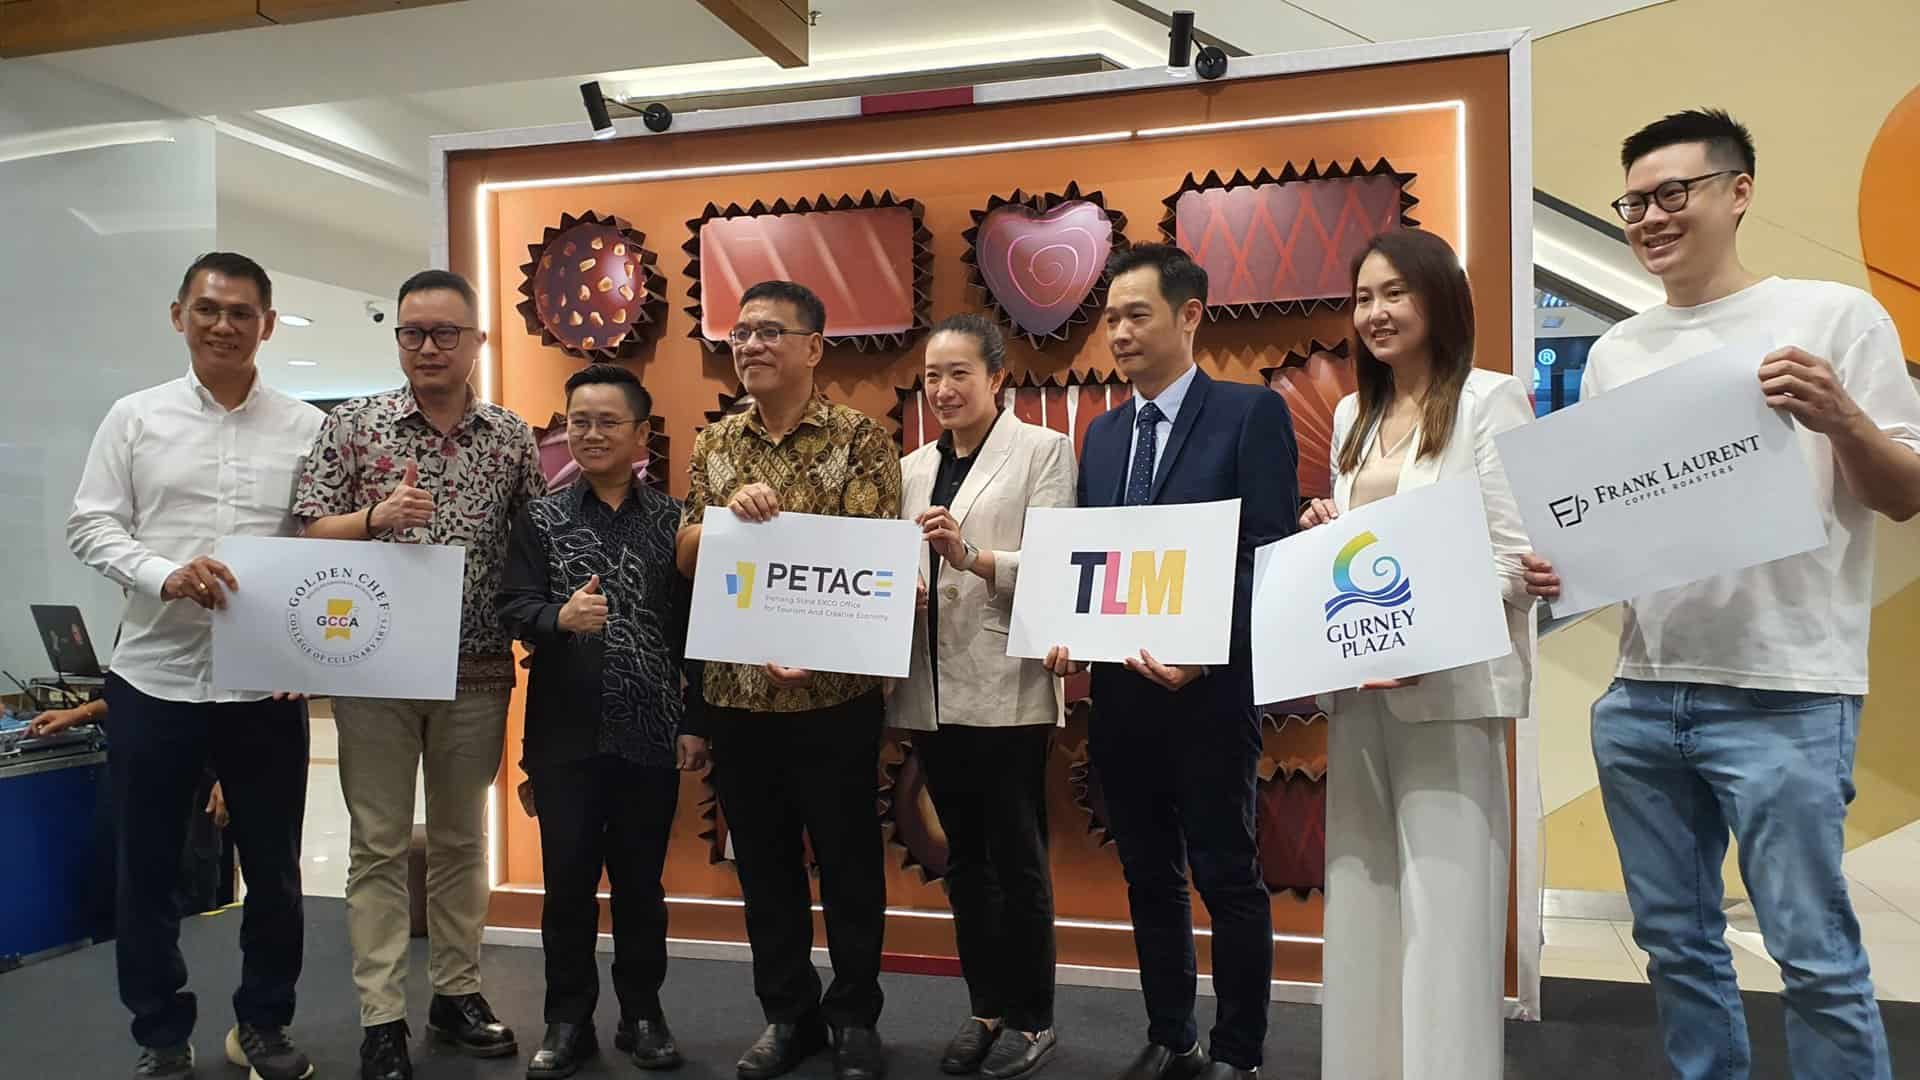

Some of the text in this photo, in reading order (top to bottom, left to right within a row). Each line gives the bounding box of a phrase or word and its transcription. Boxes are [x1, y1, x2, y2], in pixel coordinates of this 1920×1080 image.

[1594, 434, 1760, 504] FRANK LAURENT
[1625, 464, 1734, 506] COFFEE ROASTERS
[289, 567, 353, 607] GOLDEN
[358, 573, 390, 611] CHEF
[767, 562, 893, 597] PETACE
[1070, 550, 1187, 614] TLM
[316, 615, 359, 628] GCCA
[808, 607, 824, 616] And
[1327, 607, 1415, 643] GURNEY
[289, 613, 312, 654] COLLEGE
[313, 652, 325, 662] OF
[1342, 631, 1406, 659] PLAZA
